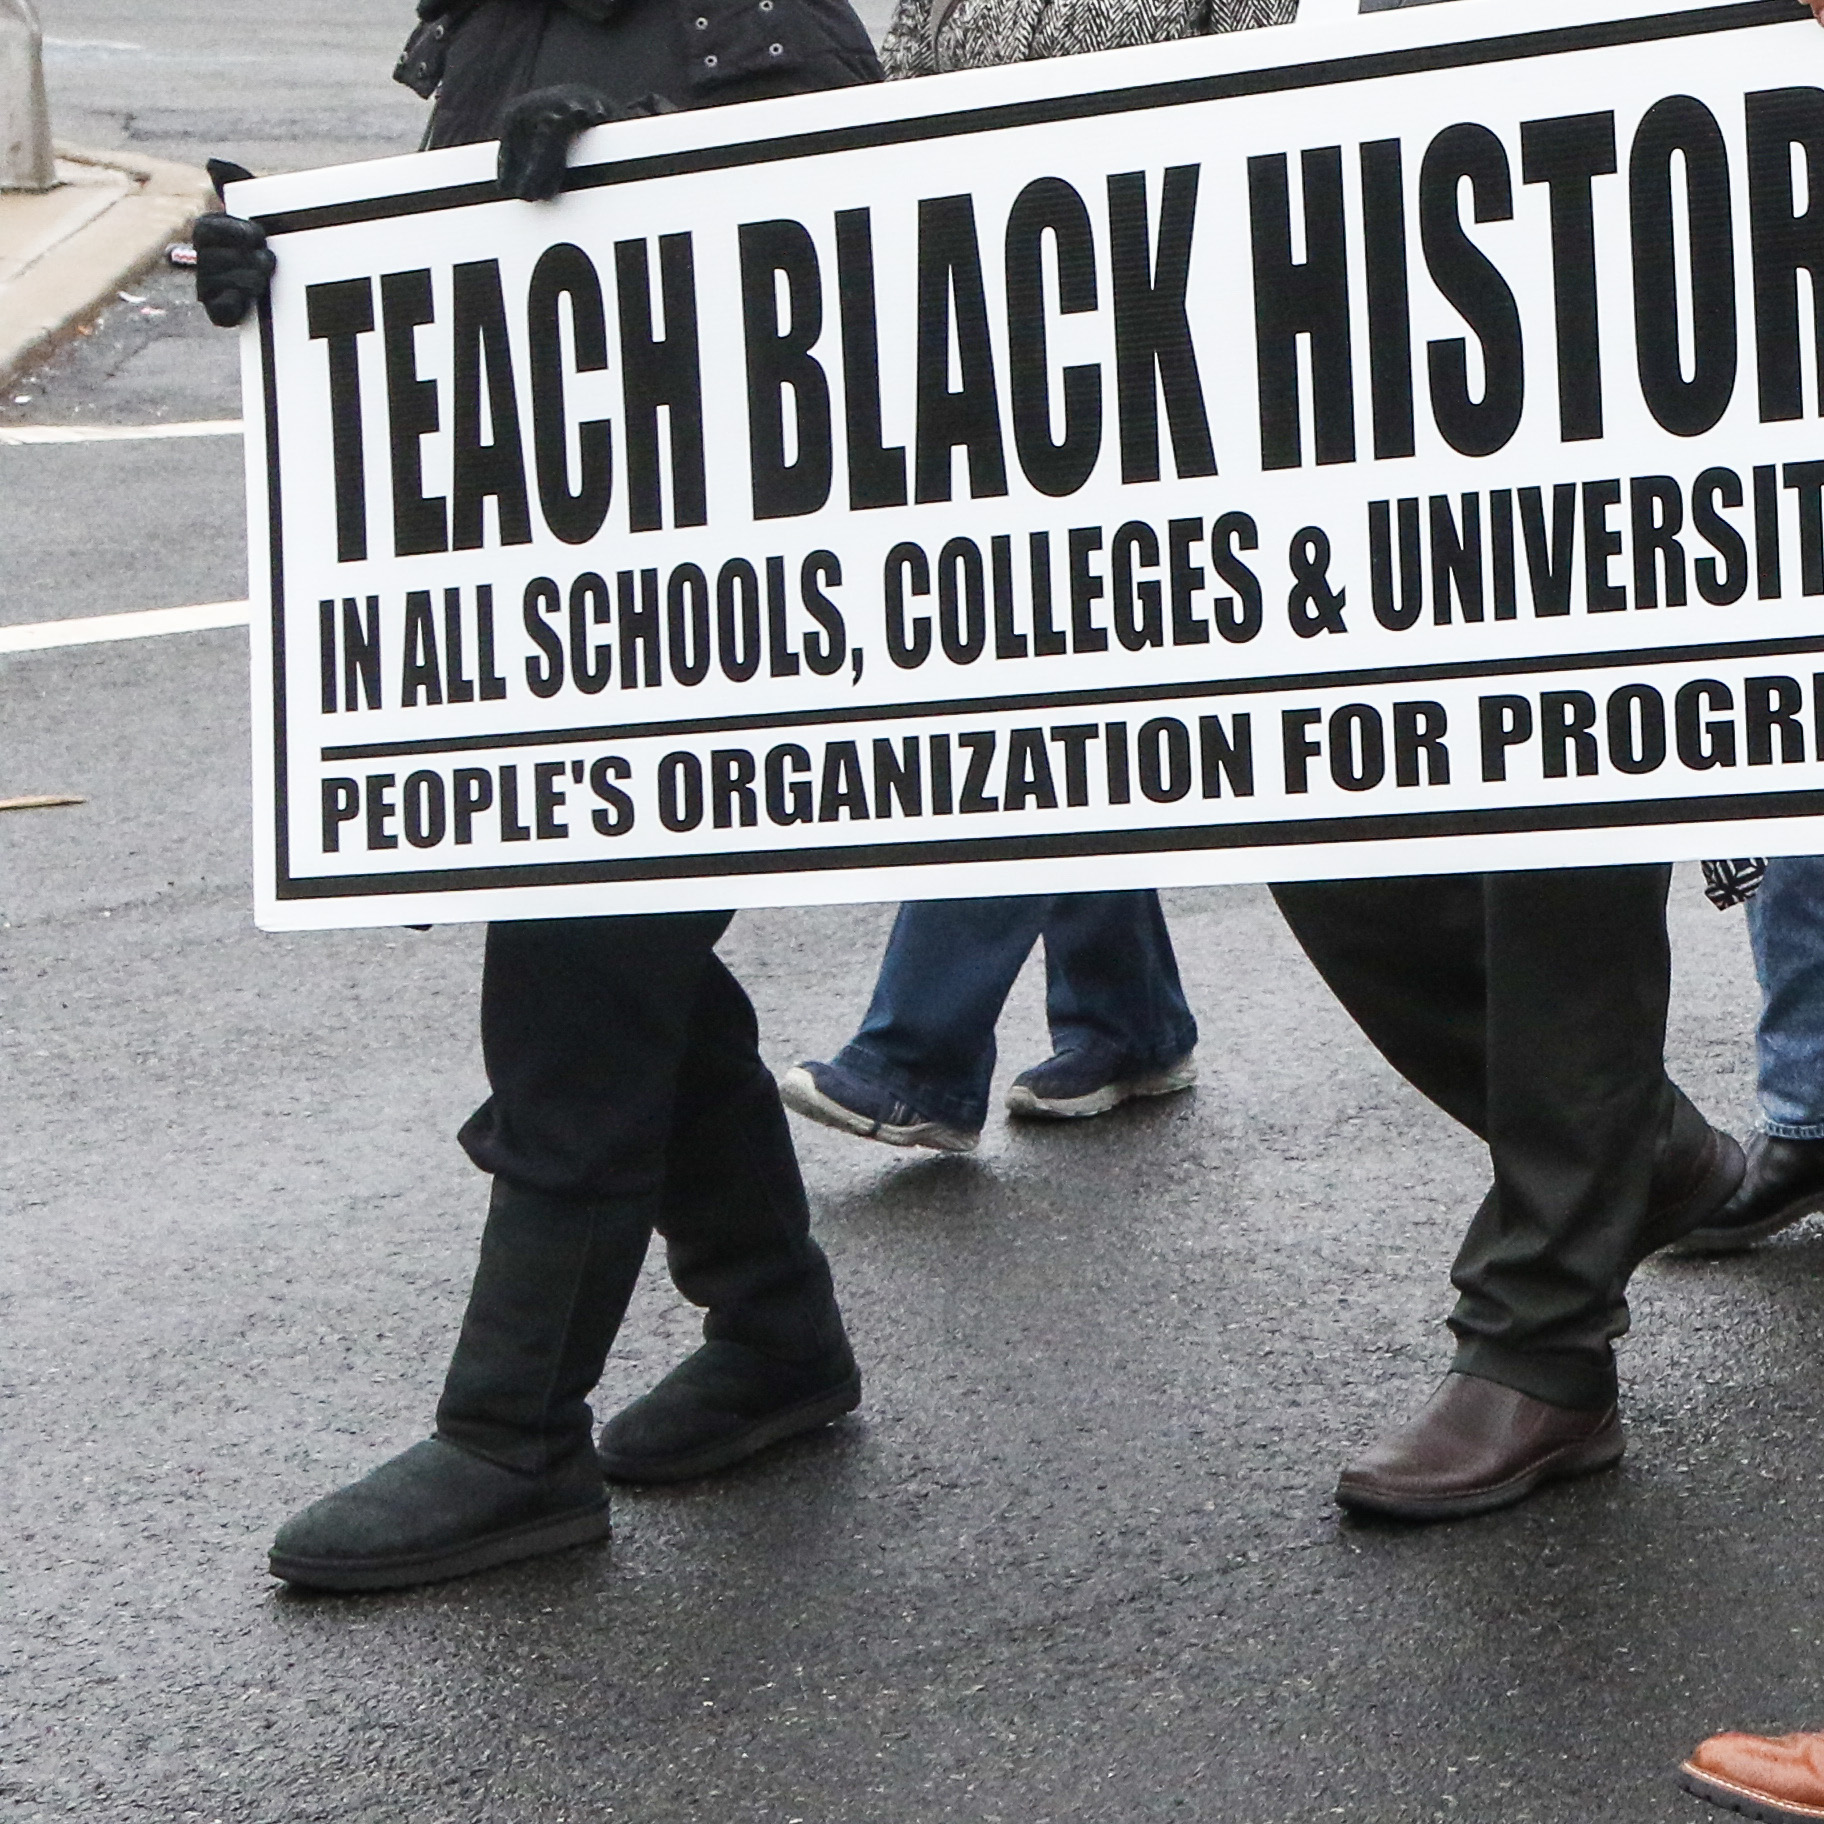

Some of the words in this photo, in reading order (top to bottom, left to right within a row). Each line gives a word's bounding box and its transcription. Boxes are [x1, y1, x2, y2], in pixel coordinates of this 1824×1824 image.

[304, 230, 709, 564] TEACH
[736, 162, 1220, 522] BLACK
[318, 594, 383, 715] IN
[400, 582, 508, 709] ALL
[522, 548, 865, 700] SCHOOLS,
[883, 509, 1264, 671] COLLEGES
[1286, 524, 1349, 640] &
[320, 754, 636, 854] PEOPLE'S
[656, 711, 1256, 834] ORGANIZATION
[1280, 699, 1452, 796] FOR
